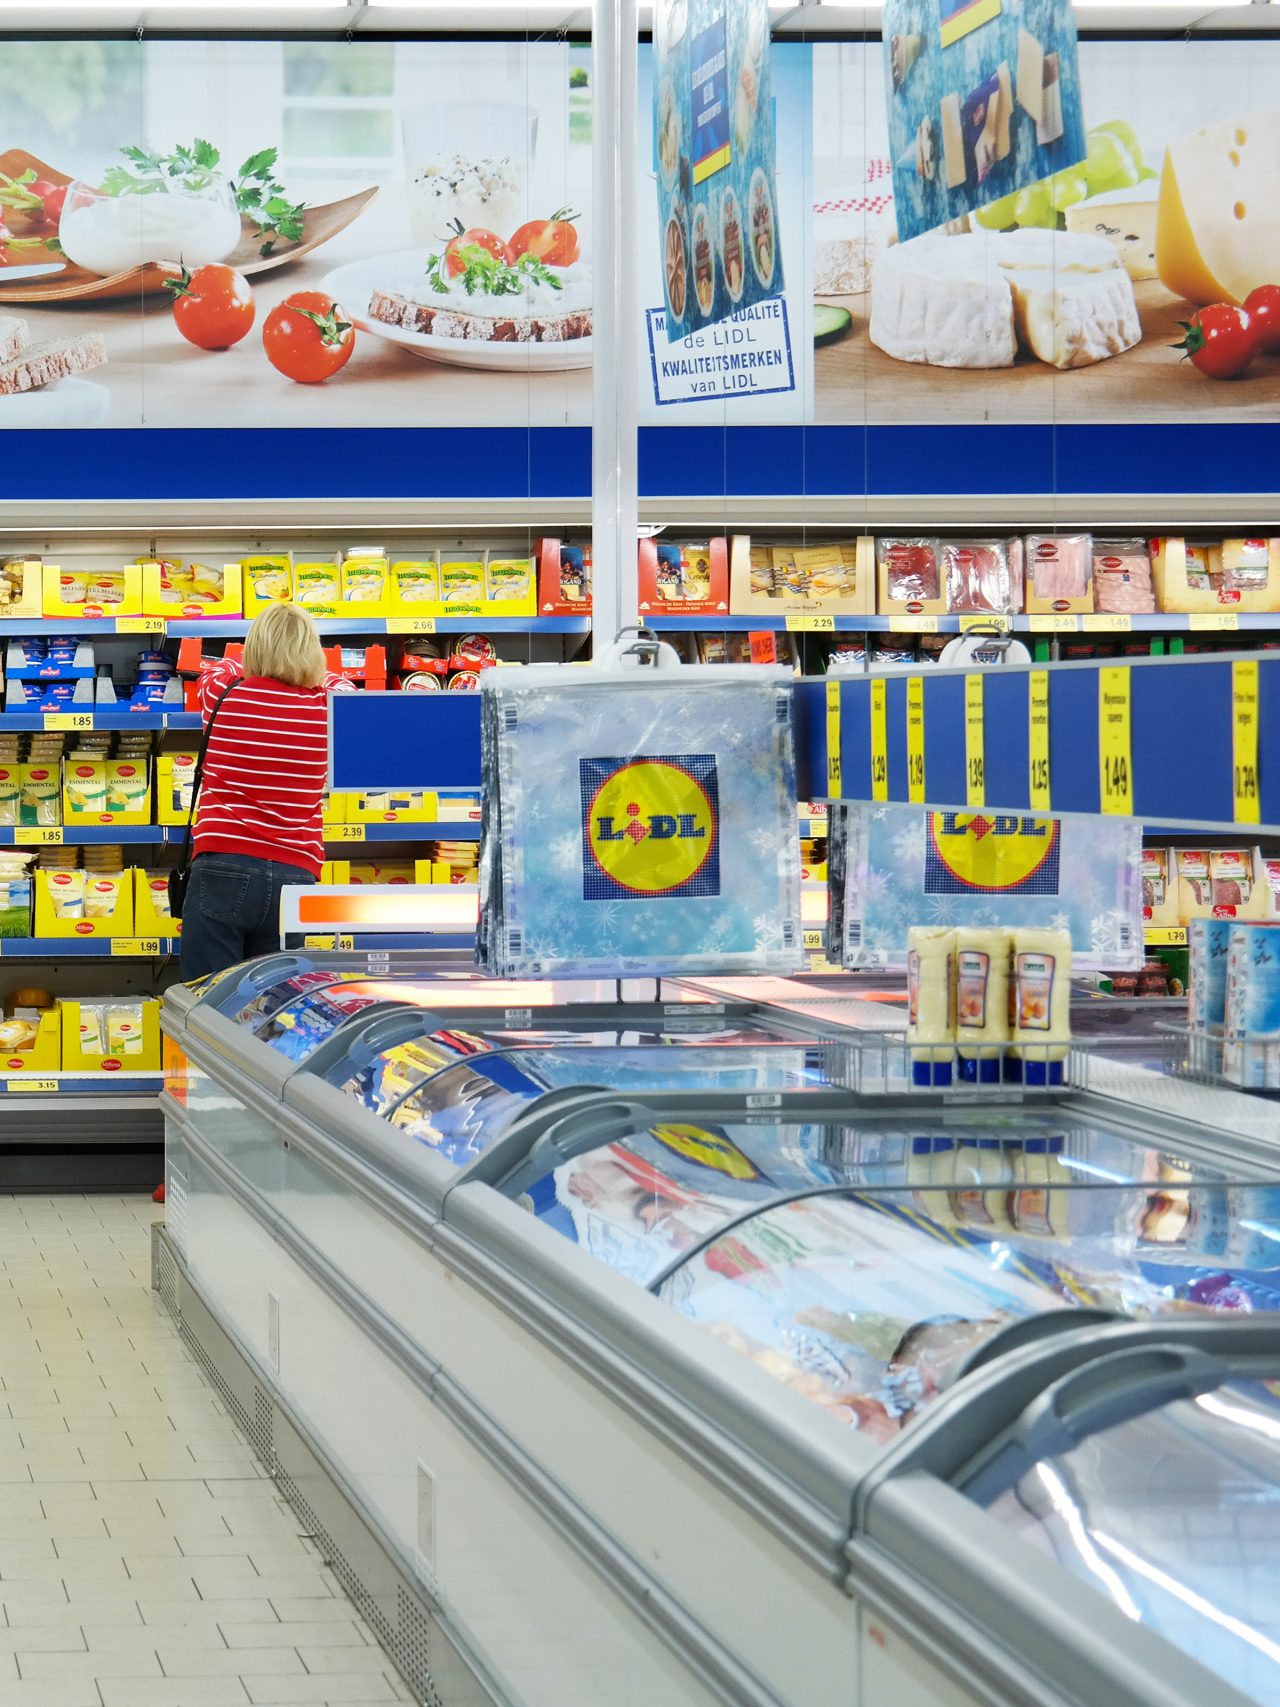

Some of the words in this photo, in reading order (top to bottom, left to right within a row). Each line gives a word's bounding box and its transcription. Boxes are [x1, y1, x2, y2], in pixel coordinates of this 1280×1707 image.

[731, 304, 780, 322] QUALITÉ
[683, 335, 705, 349] de
[714, 328, 756, 346] LIDL
[662, 349, 782, 377] KWALITEITSMERKEN
[691, 380, 716, 393] van
[723, 374, 758, 390] LIDL
[145, 621, 162, 630] 2.19
[413, 621, 433, 629] 2.66
[814, 619, 833, 628] 2.29
[988, 619, 1006, 628] 199
[72, 717, 91, 726] 1.85
[909, 754, 923, 785] 1.19
[969, 758, 983, 788] 1.39
[1032, 759, 1048, 790] 1.25
[1105, 756, 1128, 797] 1.49
[1234, 766, 1256, 798] 0.79
[42, 831, 61, 841] 1.85
[342, 827, 362, 837] 2.39
[1167, 932, 1185, 941] 1.79
[140, 942, 158, 952] 1.99
[331, 941, 352, 950] 249
[37, 1081, 56, 1089] 3.15
